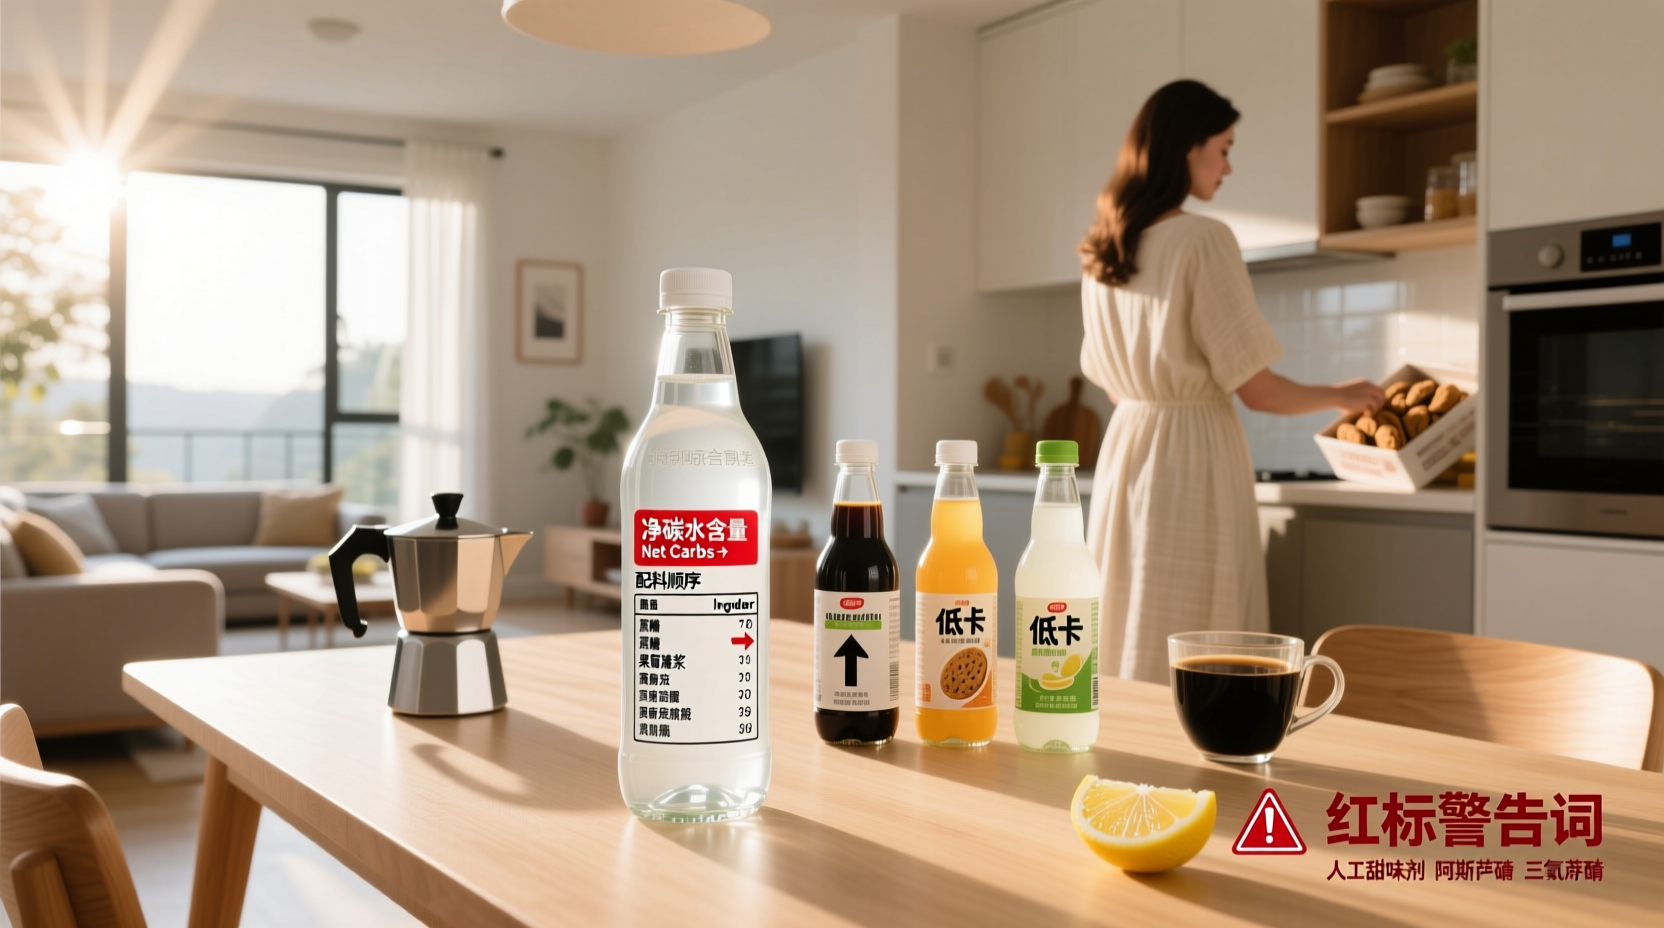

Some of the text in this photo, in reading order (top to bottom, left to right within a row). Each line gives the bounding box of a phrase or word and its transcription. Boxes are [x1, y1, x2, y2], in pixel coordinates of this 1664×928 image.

[641, 516, 748, 542] 净碳水含量
[641, 544, 715, 559] Net Carbs
[635, 571, 701, 590] 配料顺序
[935, 606, 986, 636] 低卡
[1029, 615, 1084, 647] 低卡
